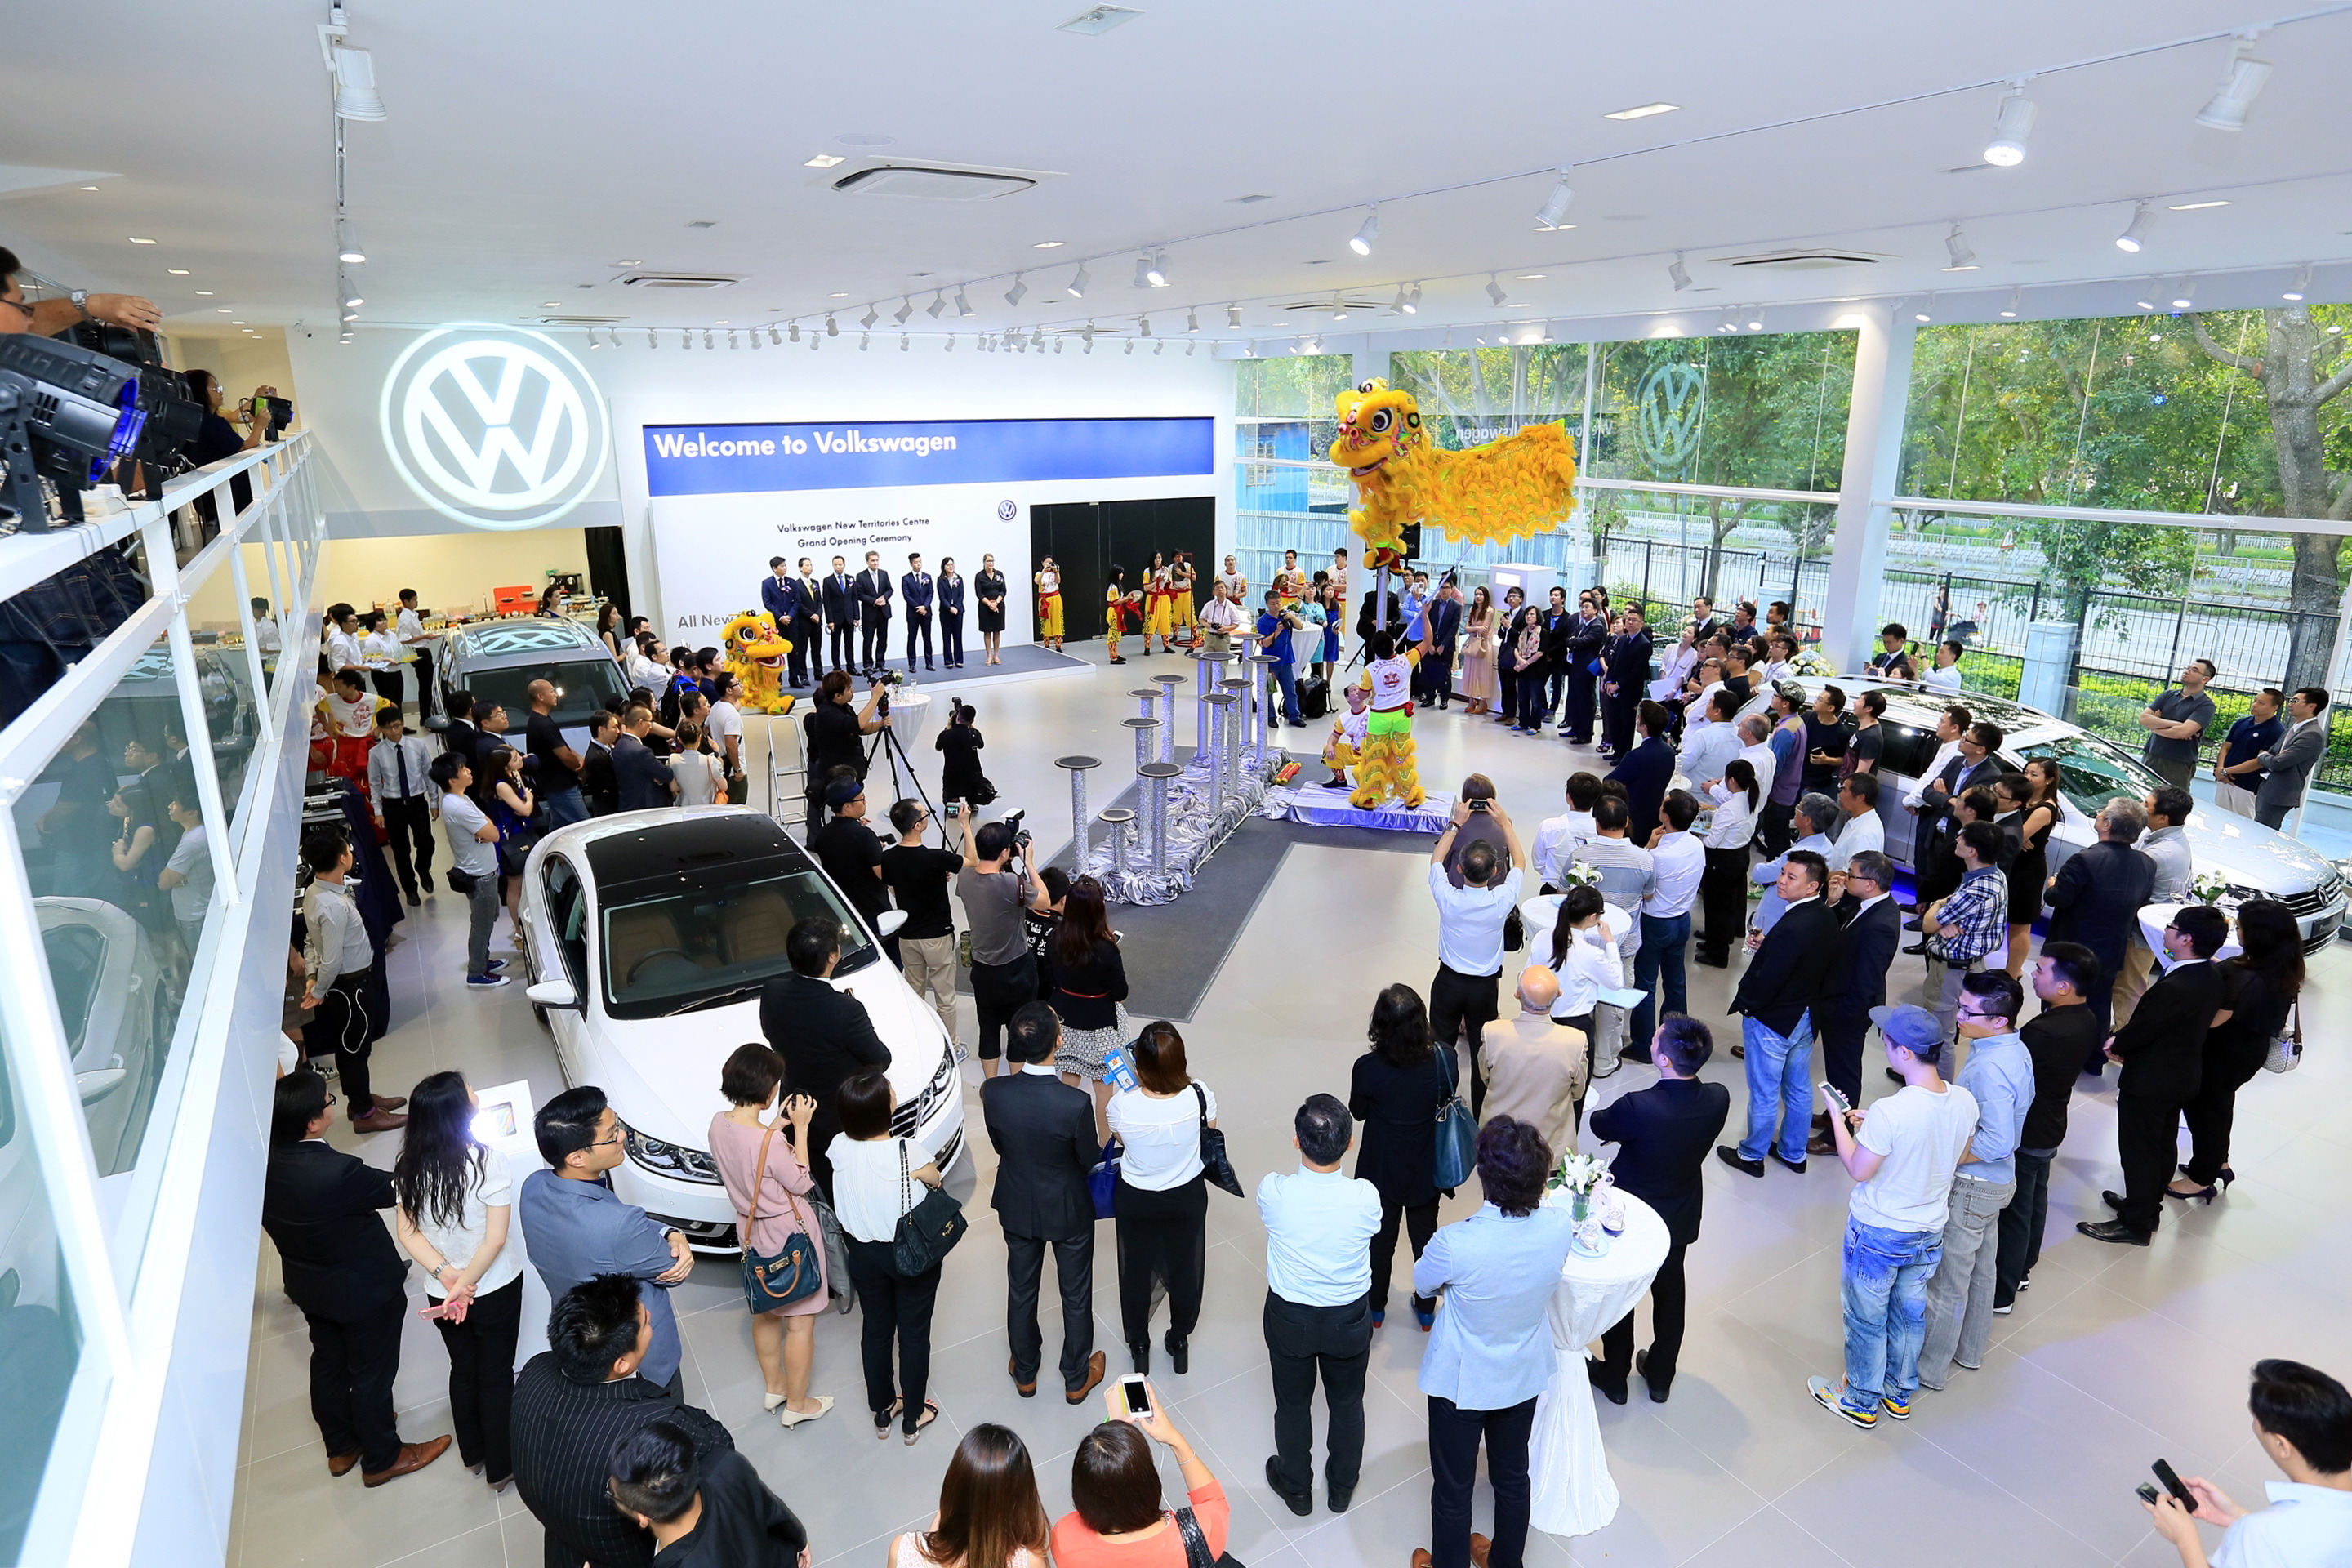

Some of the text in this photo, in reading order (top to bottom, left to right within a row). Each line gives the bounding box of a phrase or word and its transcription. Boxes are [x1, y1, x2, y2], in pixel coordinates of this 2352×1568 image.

[653, 430, 957, 458] Welcome to Volkswagen
[777, 517, 929, 533] Volkswagen New Territories Centre
[797, 534, 912, 548] Grand Opening Ceremony
[678, 613, 734, 629] All New
